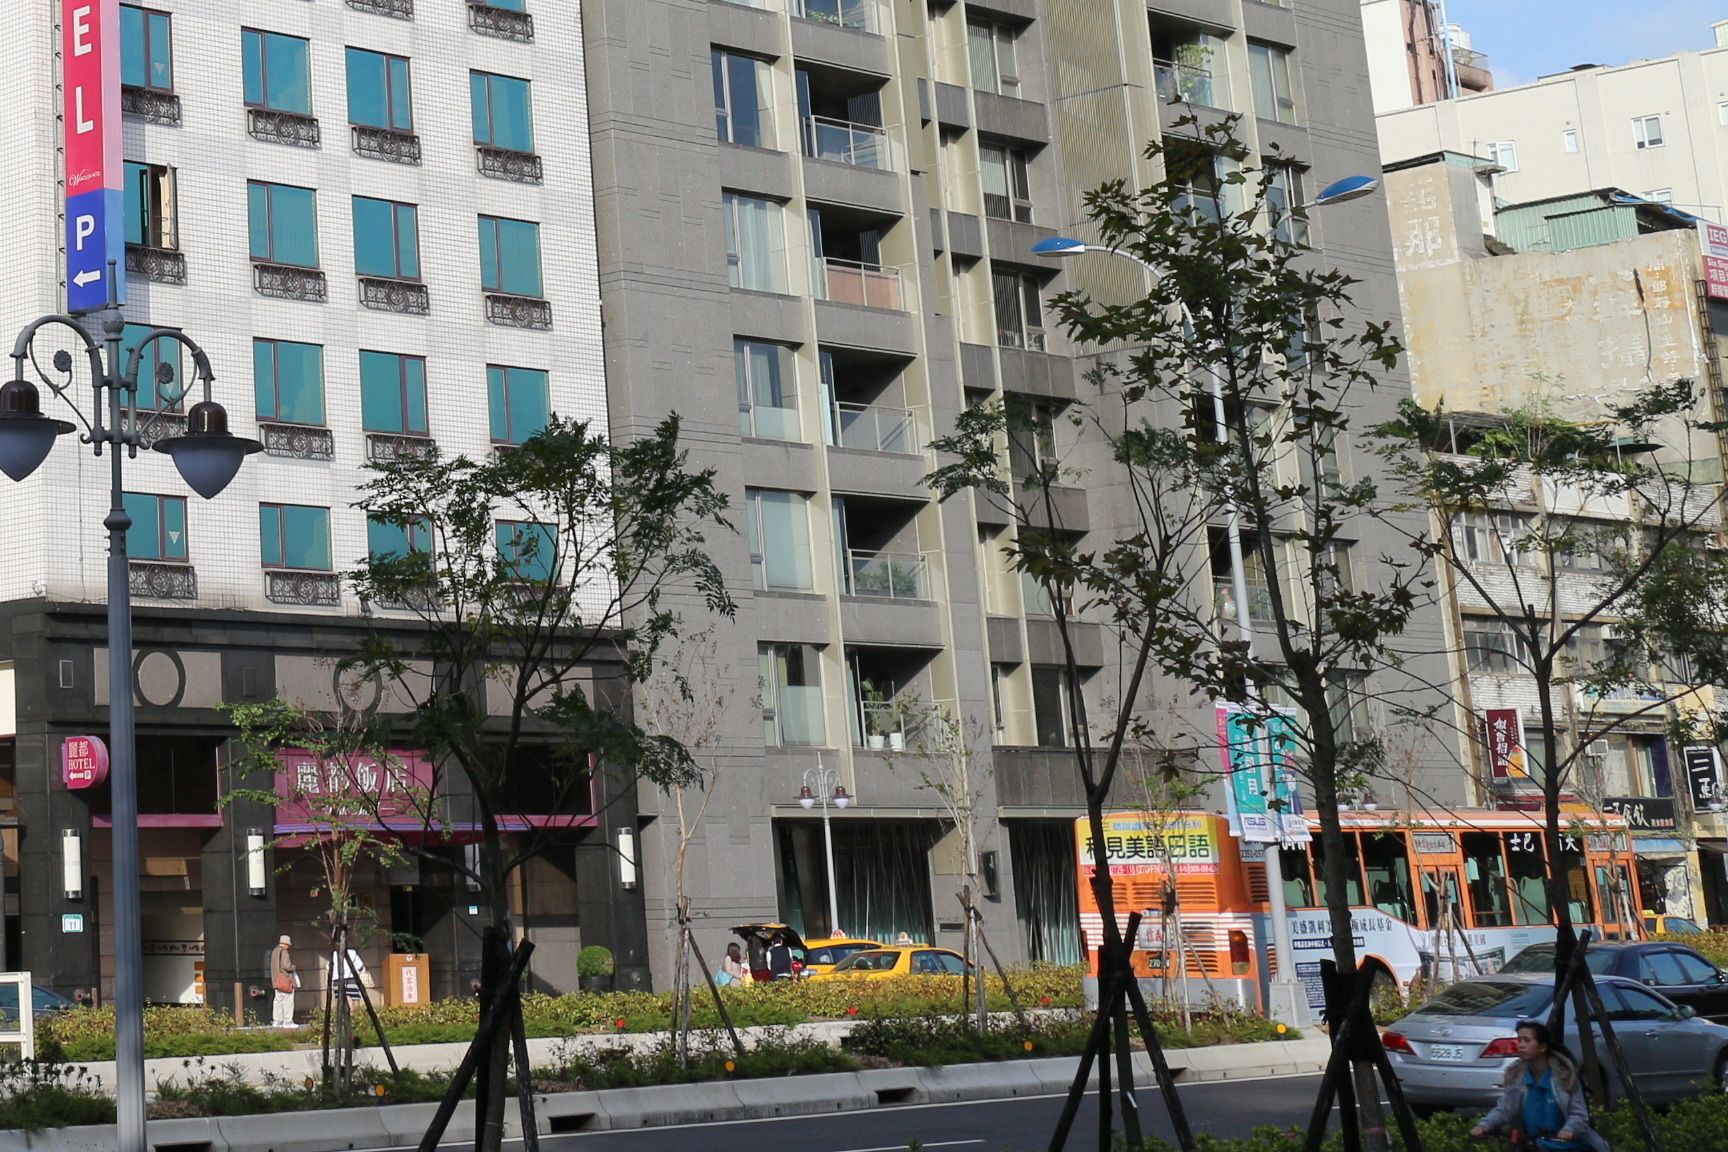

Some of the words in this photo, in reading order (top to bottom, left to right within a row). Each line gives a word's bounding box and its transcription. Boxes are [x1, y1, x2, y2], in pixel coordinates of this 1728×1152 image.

[75, 214, 95, 252] P
[68, 758, 96, 771] HOTEL
[296, 761, 408, 795] 麗都飯店
